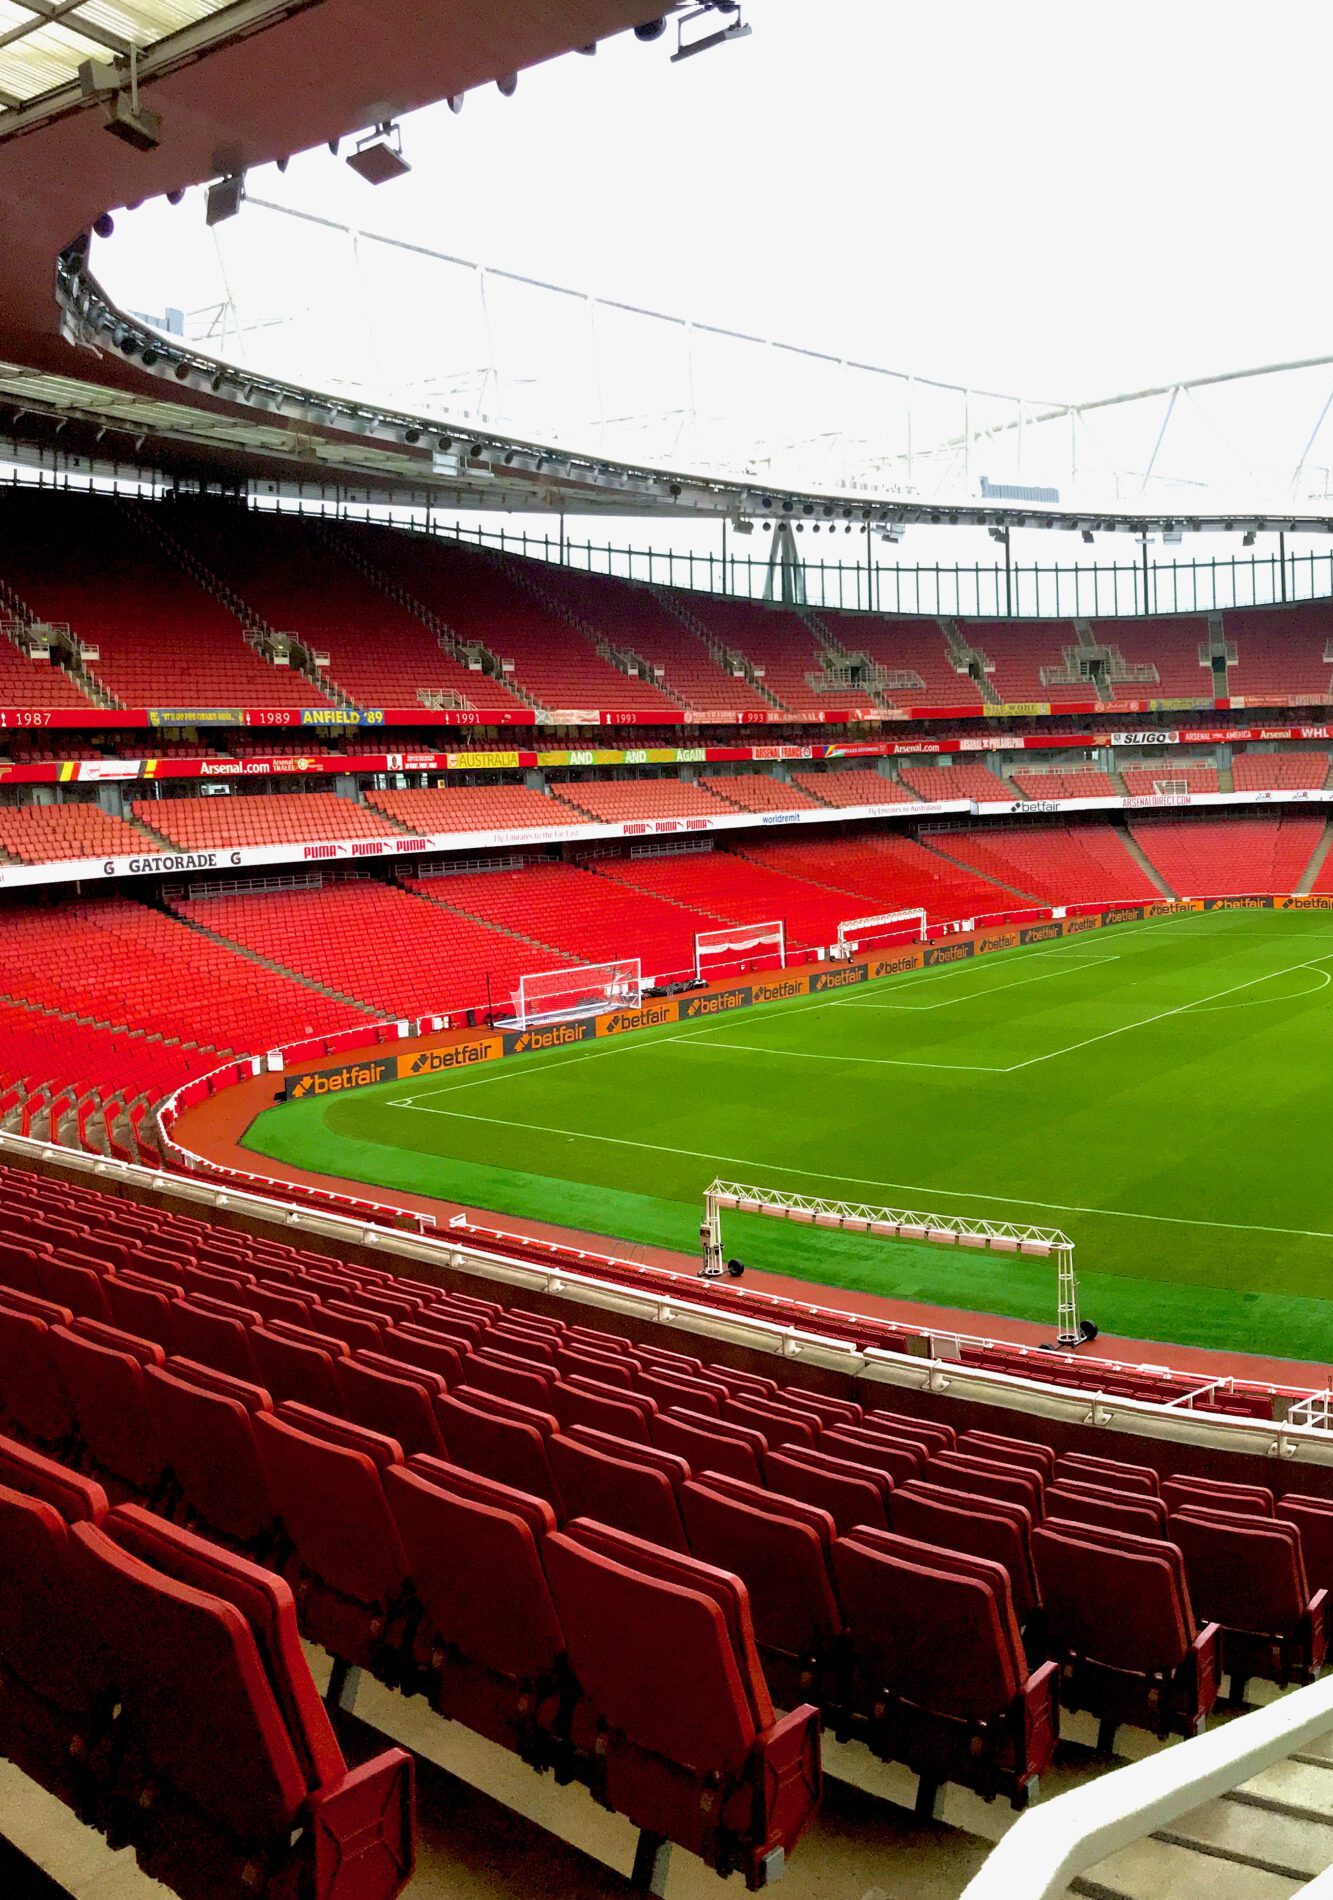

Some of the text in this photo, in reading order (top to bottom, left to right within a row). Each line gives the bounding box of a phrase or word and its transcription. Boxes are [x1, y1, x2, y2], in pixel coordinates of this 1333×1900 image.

[16, 713, 52, 726] 1987
[259, 713, 291, 724] 1989
[302, 710, 361, 724] ANFIELD
[455, 713, 481, 724] 1991
[615, 713, 637, 724] 1993
[1123, 733, 1167, 745] SLIGO
[1260, 728, 1292, 739] Arsenal
[1302, 726, 1330, 738] WHL
[570, 751, 593, 765] AND
[625, 750, 647, 763] AND
[676, 748, 706, 763] AGAIN
[893, 743, 940, 755] Arsenal.com
[200, 760, 270, 776] Arsenal.com
[460, 753, 518, 768] AUSTRALIA
[1022, 801, 1061, 812] betfair
[762, 812, 800, 824] worldremit
[623, 818, 708, 835] PUMA PUMA PUMA
[303, 839, 427, 860] PUMA PUMA PUMA
[129, 853, 217, 873] GATORADE
[1154, 901, 1196, 914] betfair
[1223, 897, 1265, 909] betfair
[1110, 909, 1139, 924] betfair
[986, 934, 1016, 951] betfair
[939, 944, 970, 963] betfair
[884, 955, 919, 975] betfair
[825, 968, 864, 988] betfair
[763, 979, 803, 1000] betfair
[700, 992, 745, 1015] betfair
[620, 1007, 669, 1031] betfair
[529, 1024, 586, 1050] betfair
[430, 1043, 493, 1070] betfair
[313, 1064, 386, 1095] betfair
